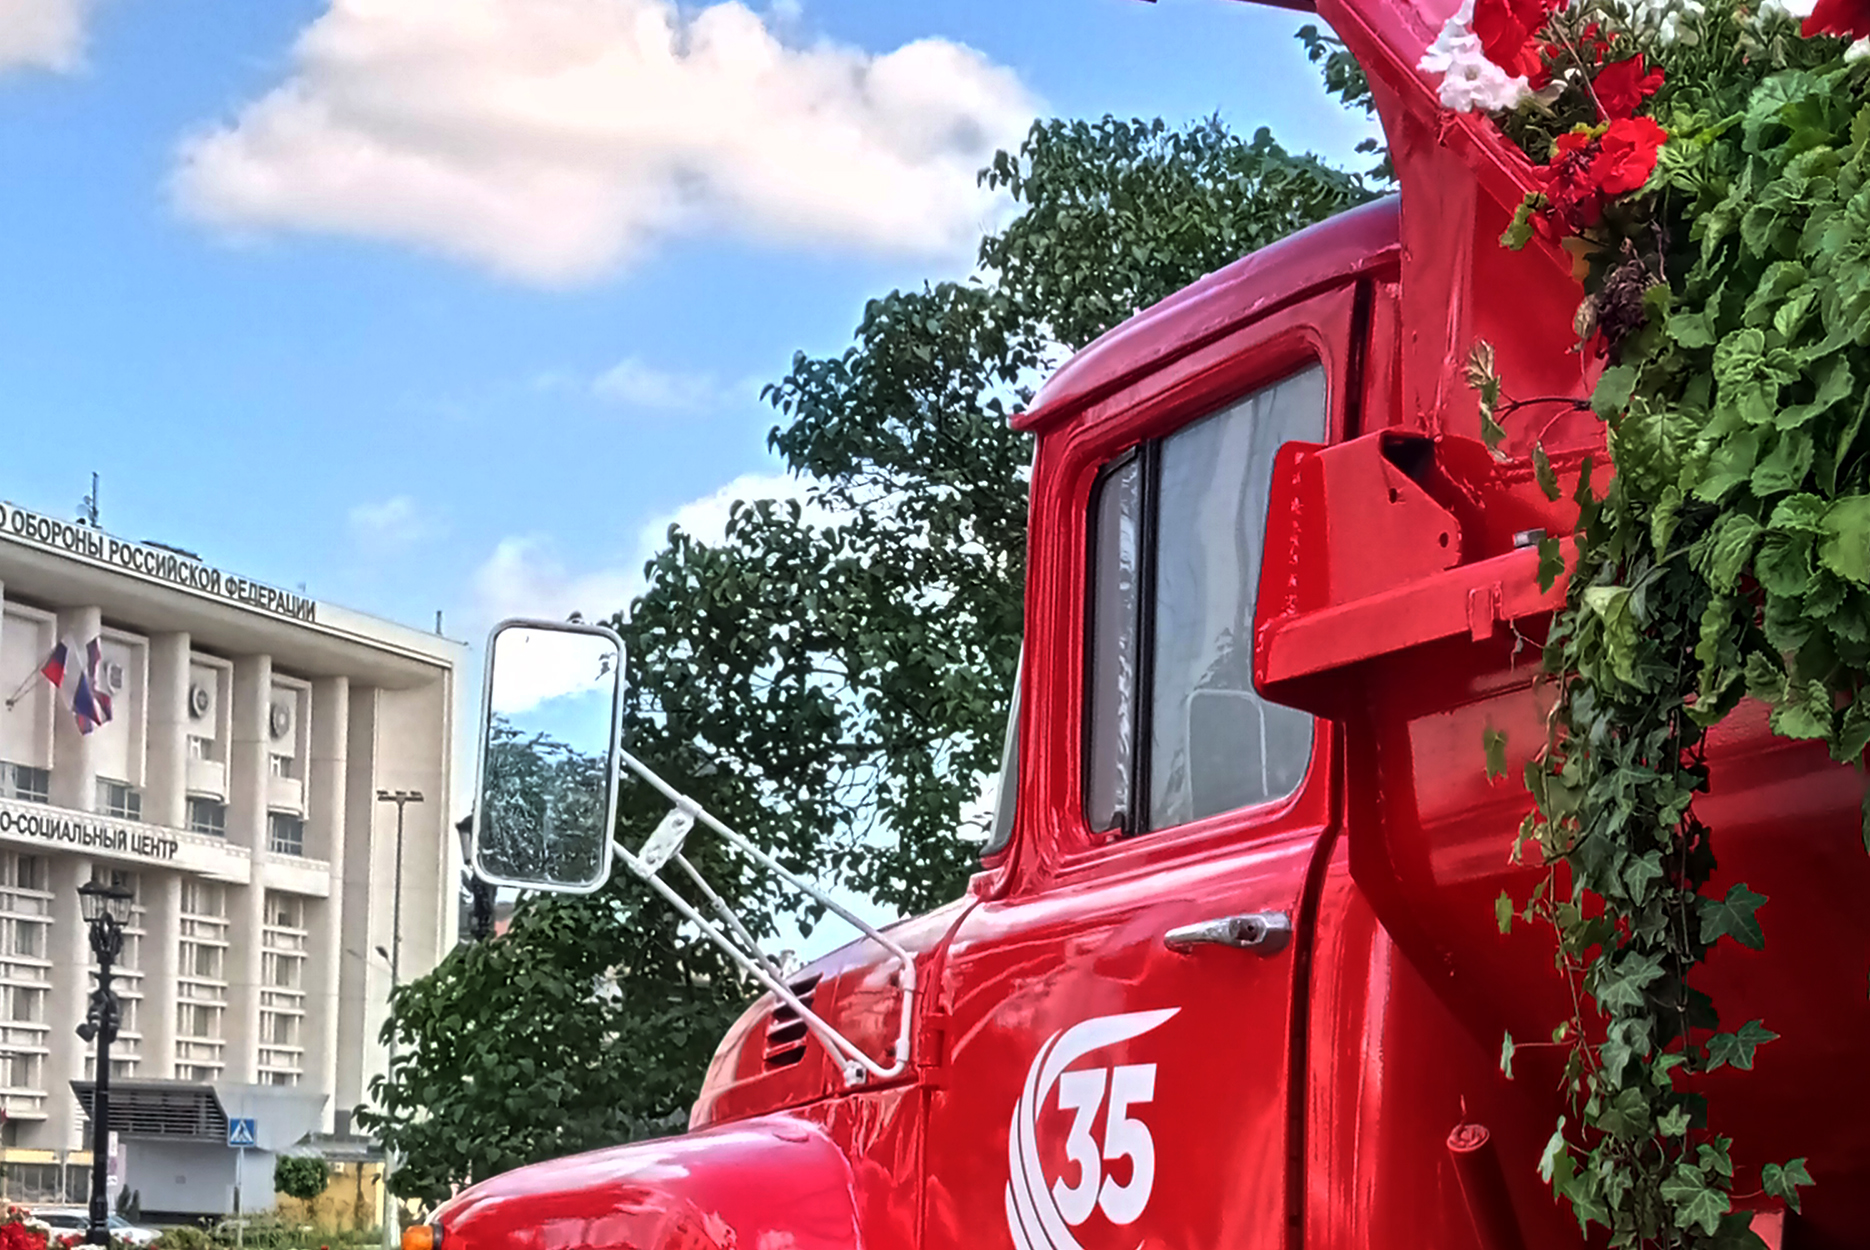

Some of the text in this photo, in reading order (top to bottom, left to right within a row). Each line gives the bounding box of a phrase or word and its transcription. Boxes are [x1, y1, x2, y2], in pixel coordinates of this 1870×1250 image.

[11, 510, 103, 558] ОБОРОНЫ
[108, 539, 221, 595] РОССИЙСКОЙ
[225, 576, 317, 623] ФЕДЕРАЦИИ
[0, 811, 179, 860] О-СОЦИАЛЬНЫЙ ЦЕНТР
[1051, 1063, 1158, 1227] 35
